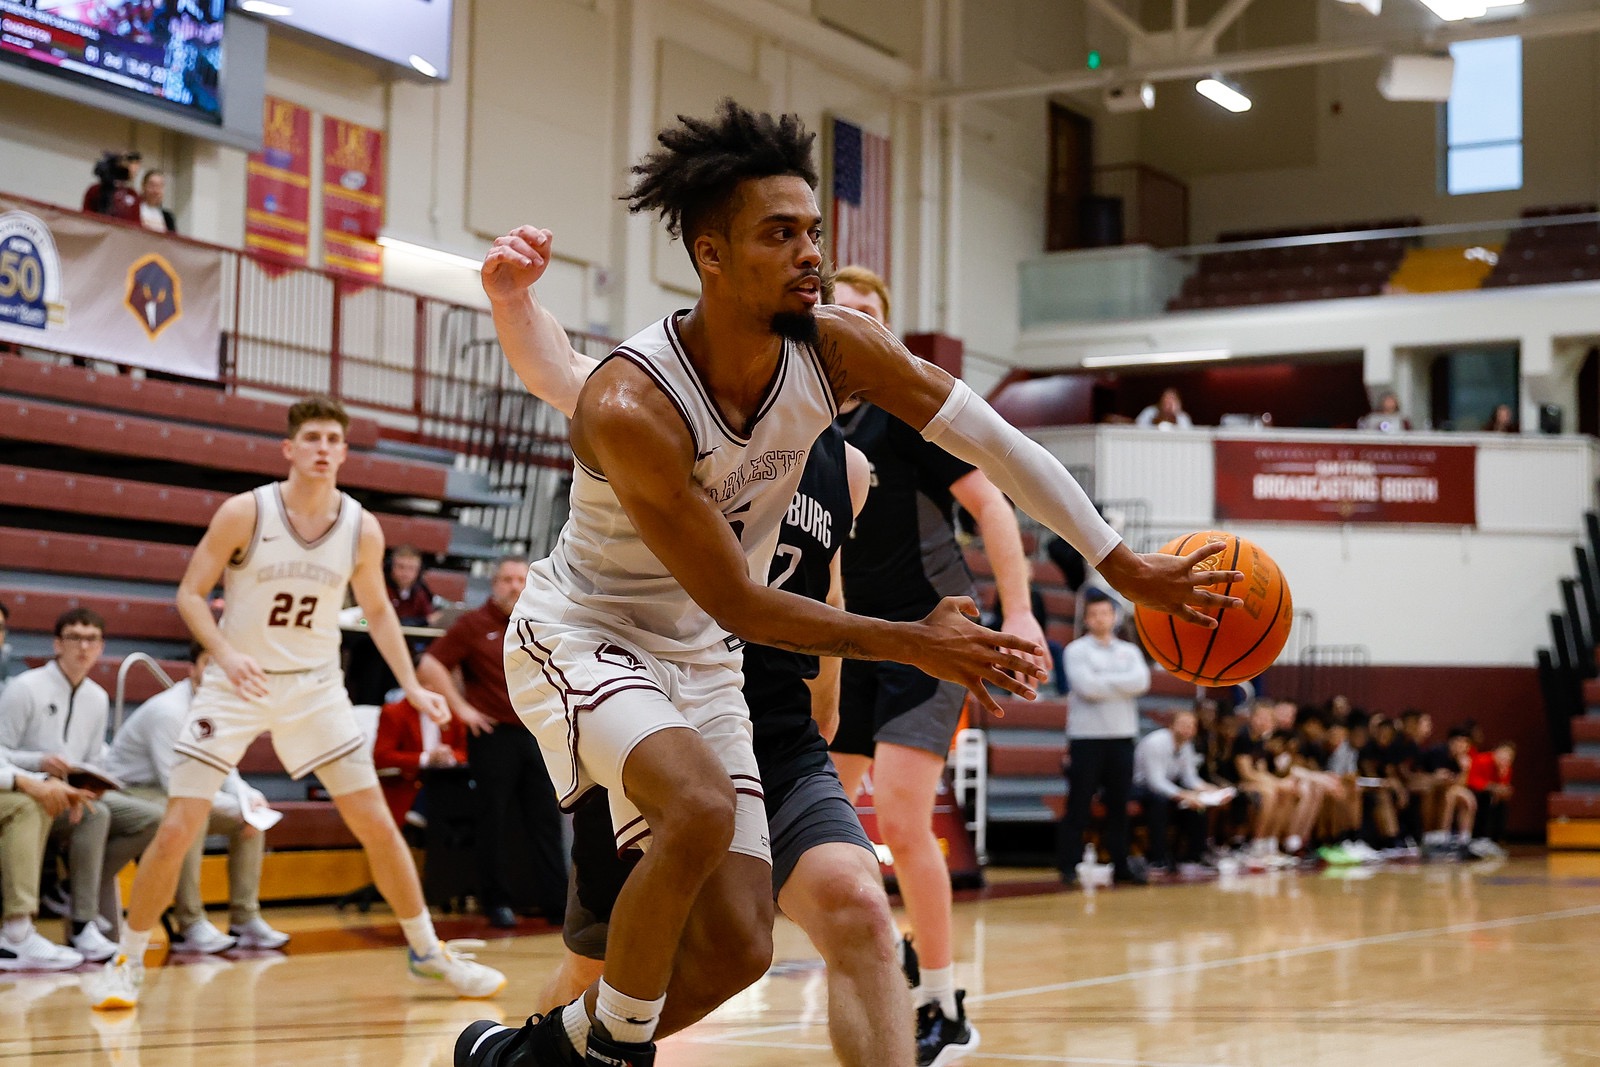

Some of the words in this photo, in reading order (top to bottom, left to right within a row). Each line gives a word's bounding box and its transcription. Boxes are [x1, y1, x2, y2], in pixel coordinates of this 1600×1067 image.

[0, 250, 42, 302] 50
[1253, 473, 1380, 501] BROADCASTING
[1381, 476, 1439, 503] BOOTH
[786, 492, 832, 549] BURG
[268, 592, 318, 629] 22
